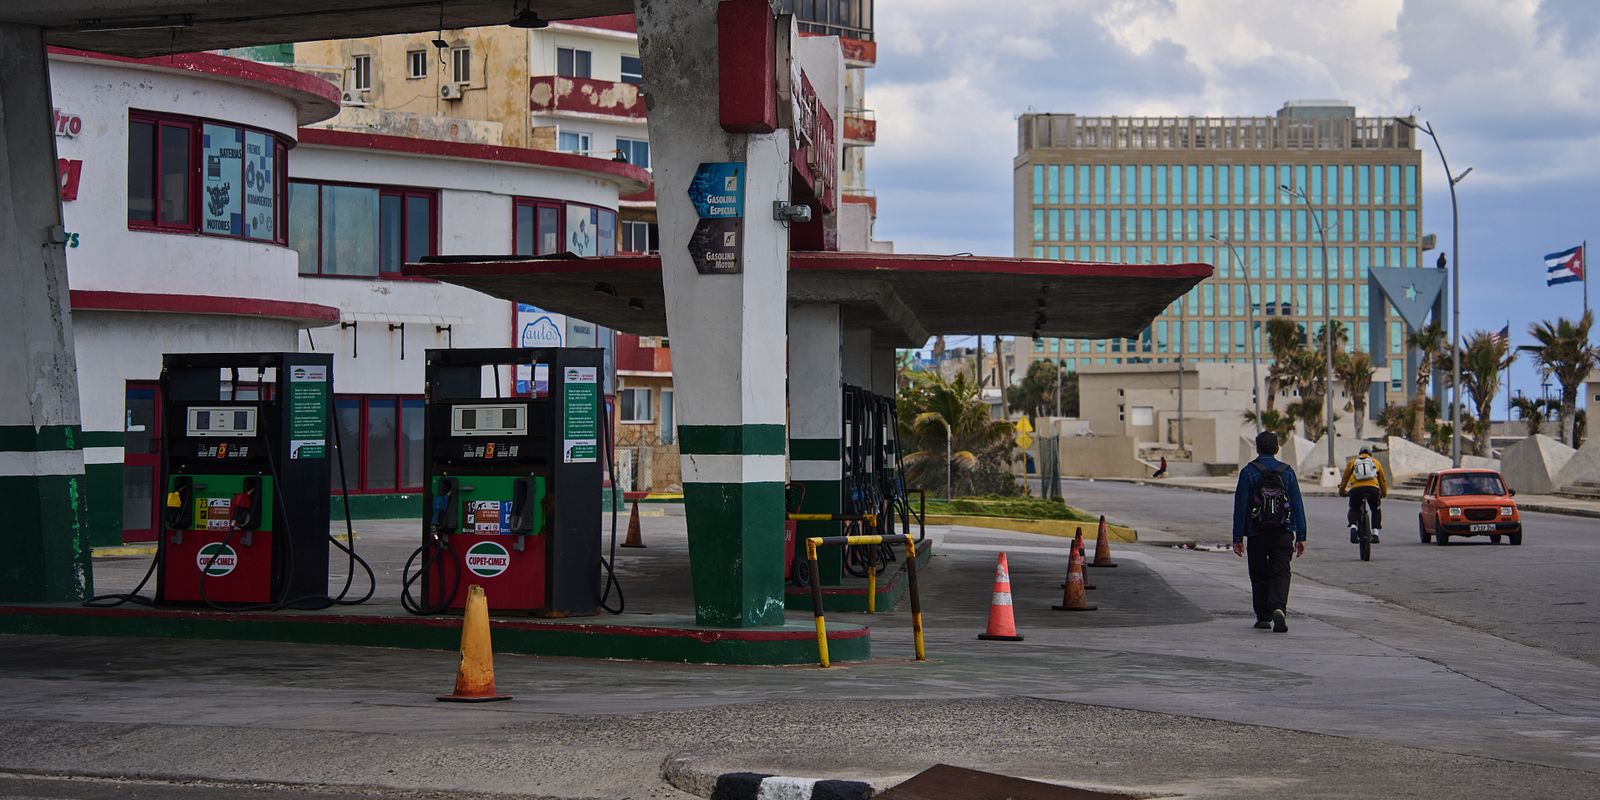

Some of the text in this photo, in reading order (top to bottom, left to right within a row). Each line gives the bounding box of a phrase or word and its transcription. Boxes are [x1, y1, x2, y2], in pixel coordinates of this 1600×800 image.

[707, 194, 737, 204] GASOLINA
[710, 206, 737, 215] ESPECIAL
[207, 219, 230, 231] MOTORES
[706, 251, 736, 261] GASOLINA
[469, 557, 507, 567] CUPET-CIMEX
